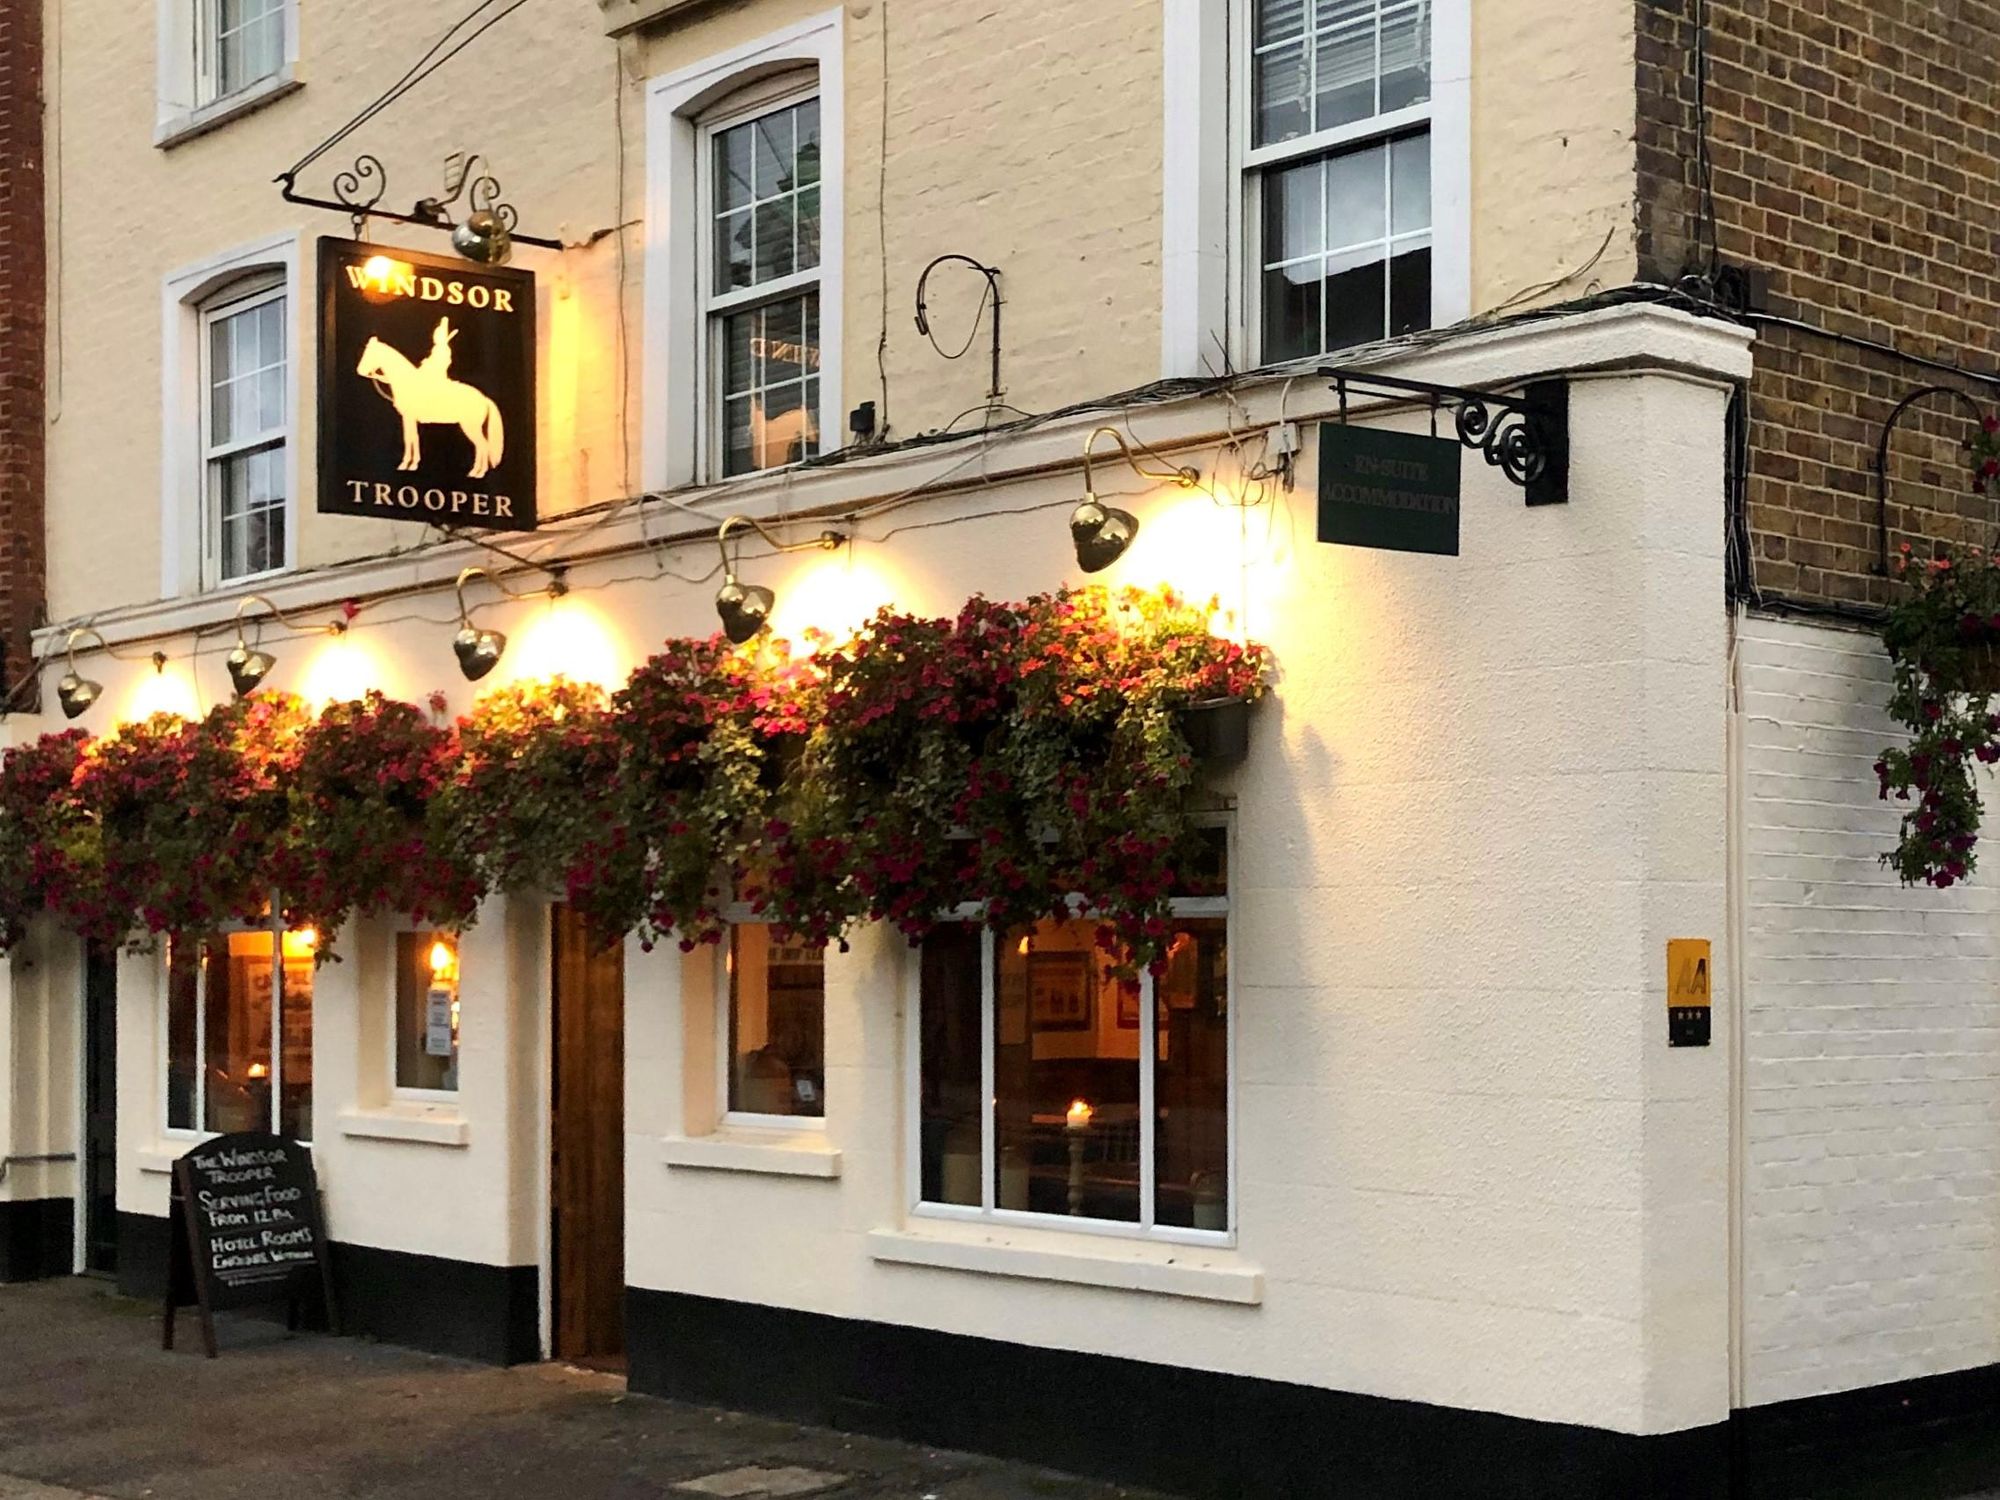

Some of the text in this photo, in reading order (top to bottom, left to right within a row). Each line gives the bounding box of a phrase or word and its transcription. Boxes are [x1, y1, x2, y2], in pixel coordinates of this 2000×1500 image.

[346, 263, 514, 313] WINDSOR
[347, 479, 514, 518] TROOPER
[218, 1148, 288, 1167] WINDSOR
[206, 1166, 276, 1184] TROOPER
[198, 1185, 301, 1212] SERVING FOOD
[208, 1211, 249, 1227] FROM
[211, 1227, 314, 1253] HOTEL ROOMS
